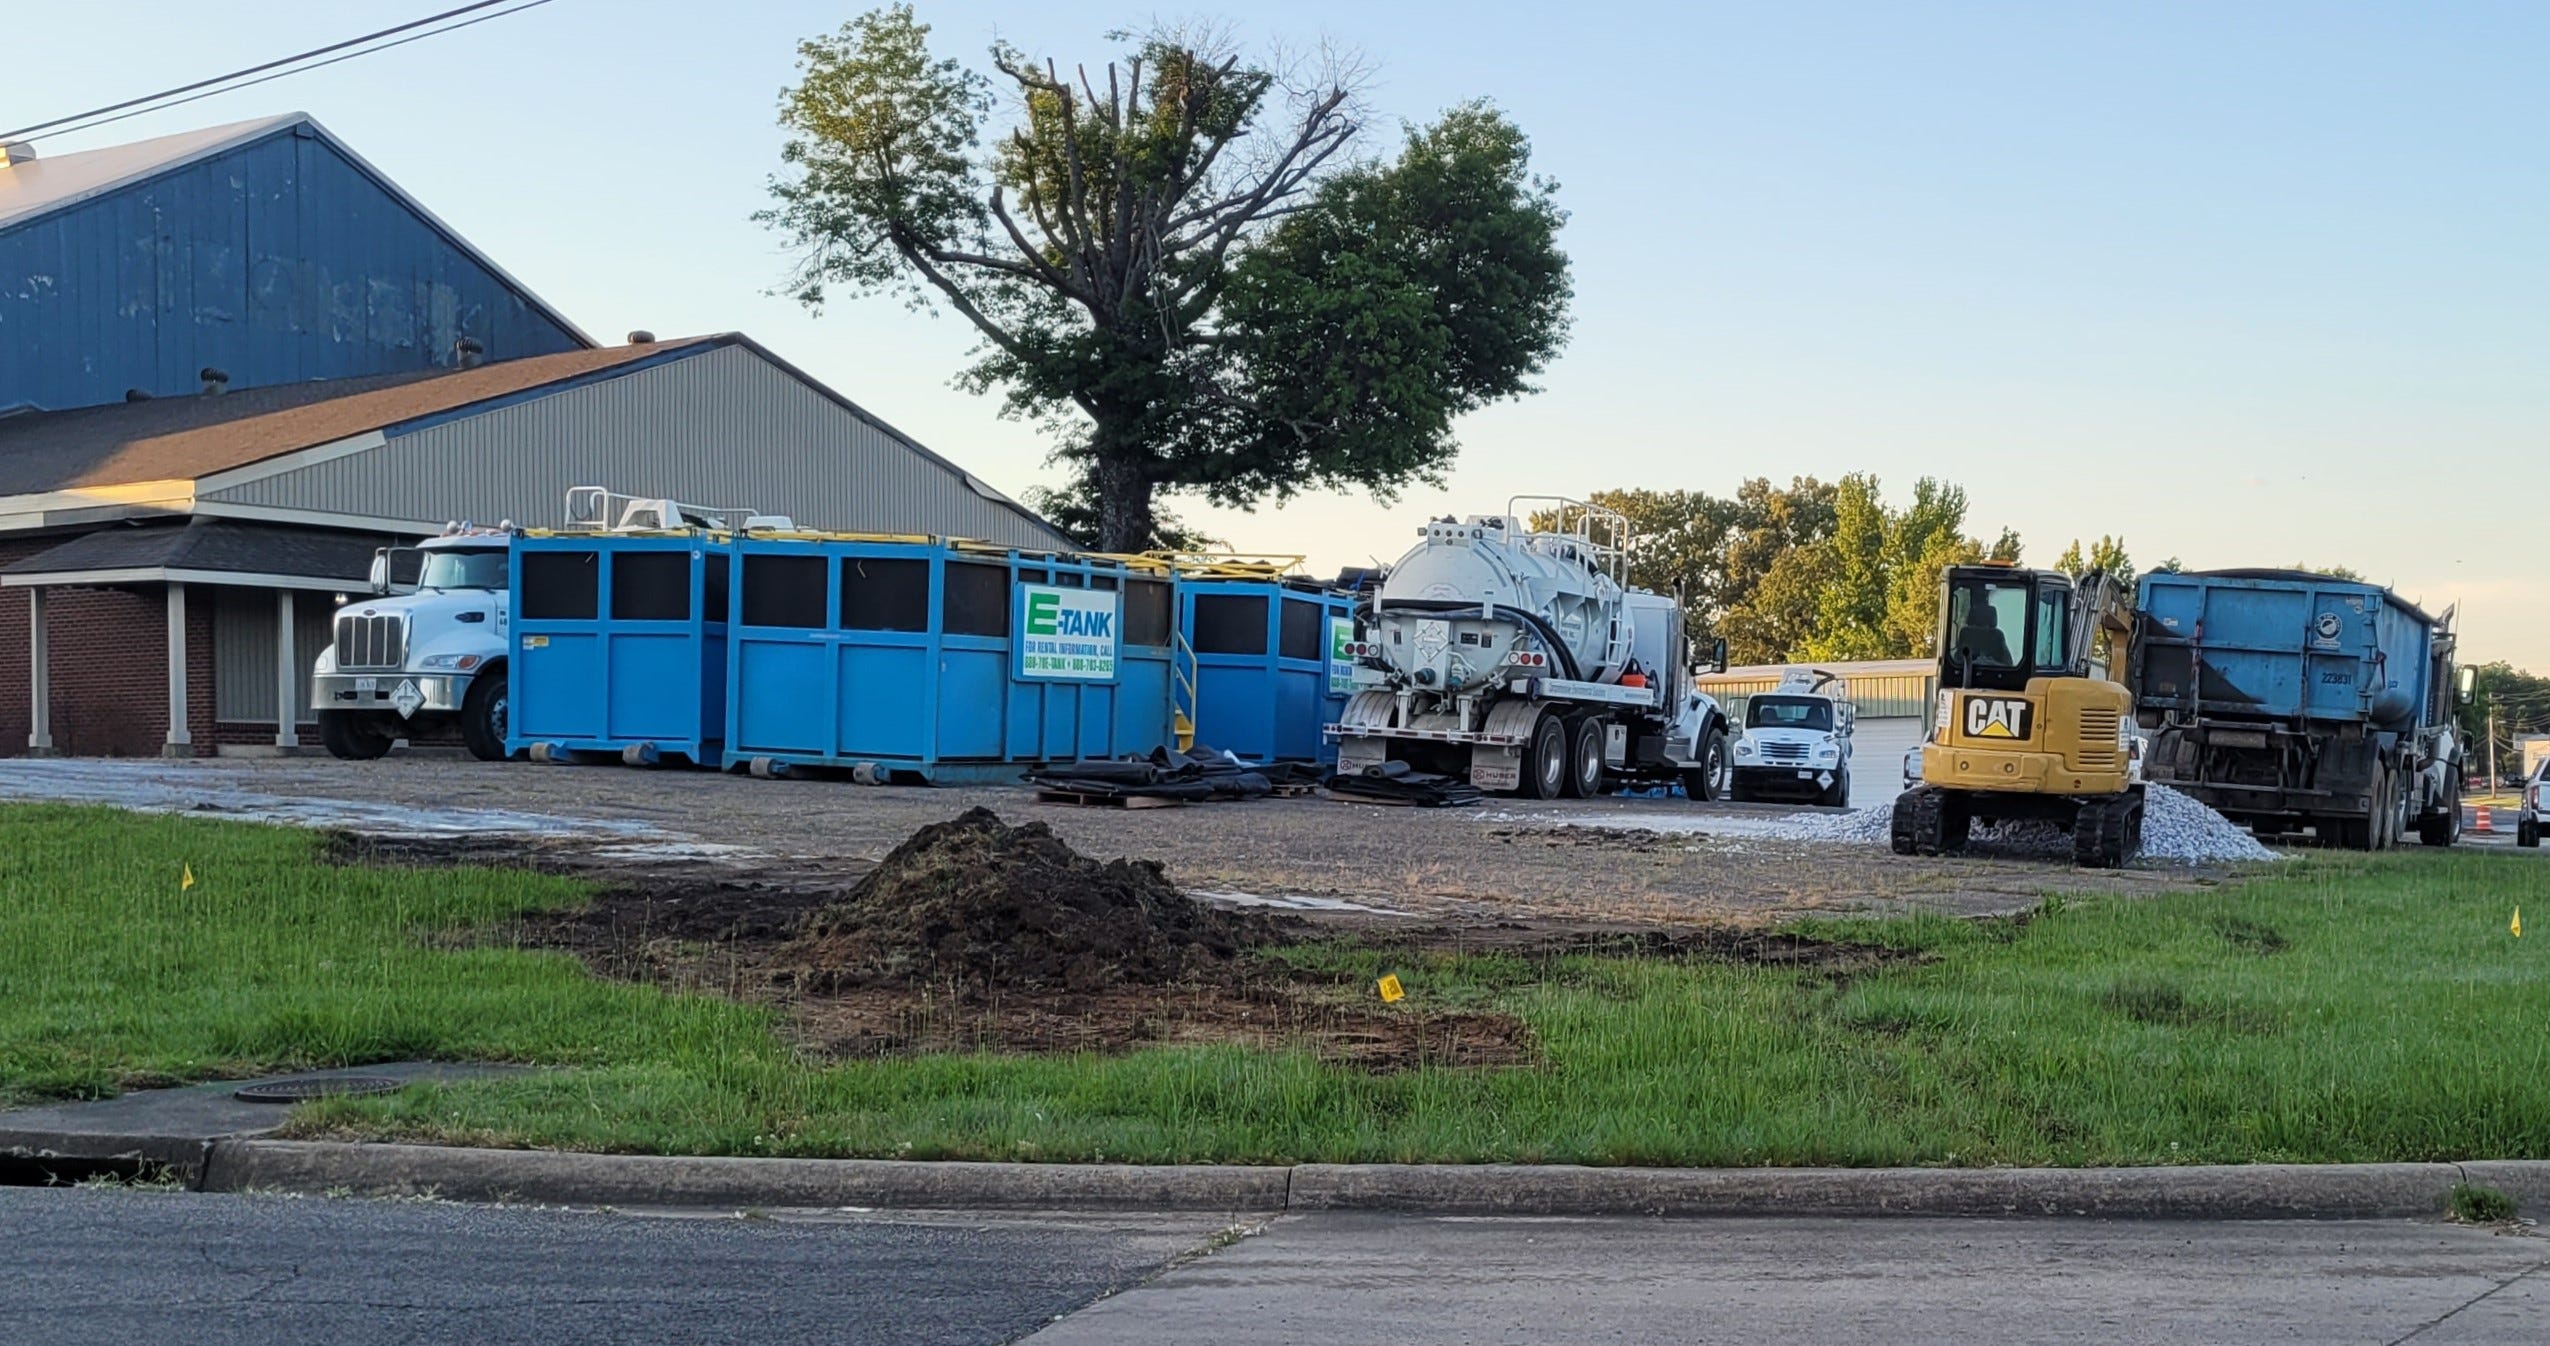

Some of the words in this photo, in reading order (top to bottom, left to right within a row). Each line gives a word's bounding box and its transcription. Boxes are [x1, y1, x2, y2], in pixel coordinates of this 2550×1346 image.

[1027, 592, 1113, 638] E-TANK
[1025, 640, 1036, 653] FOR
[1037, 641, 1057, 654] RENTAL
[1100, 644, 1113, 657] CALL
[1968, 698, 2026, 738] CAT
